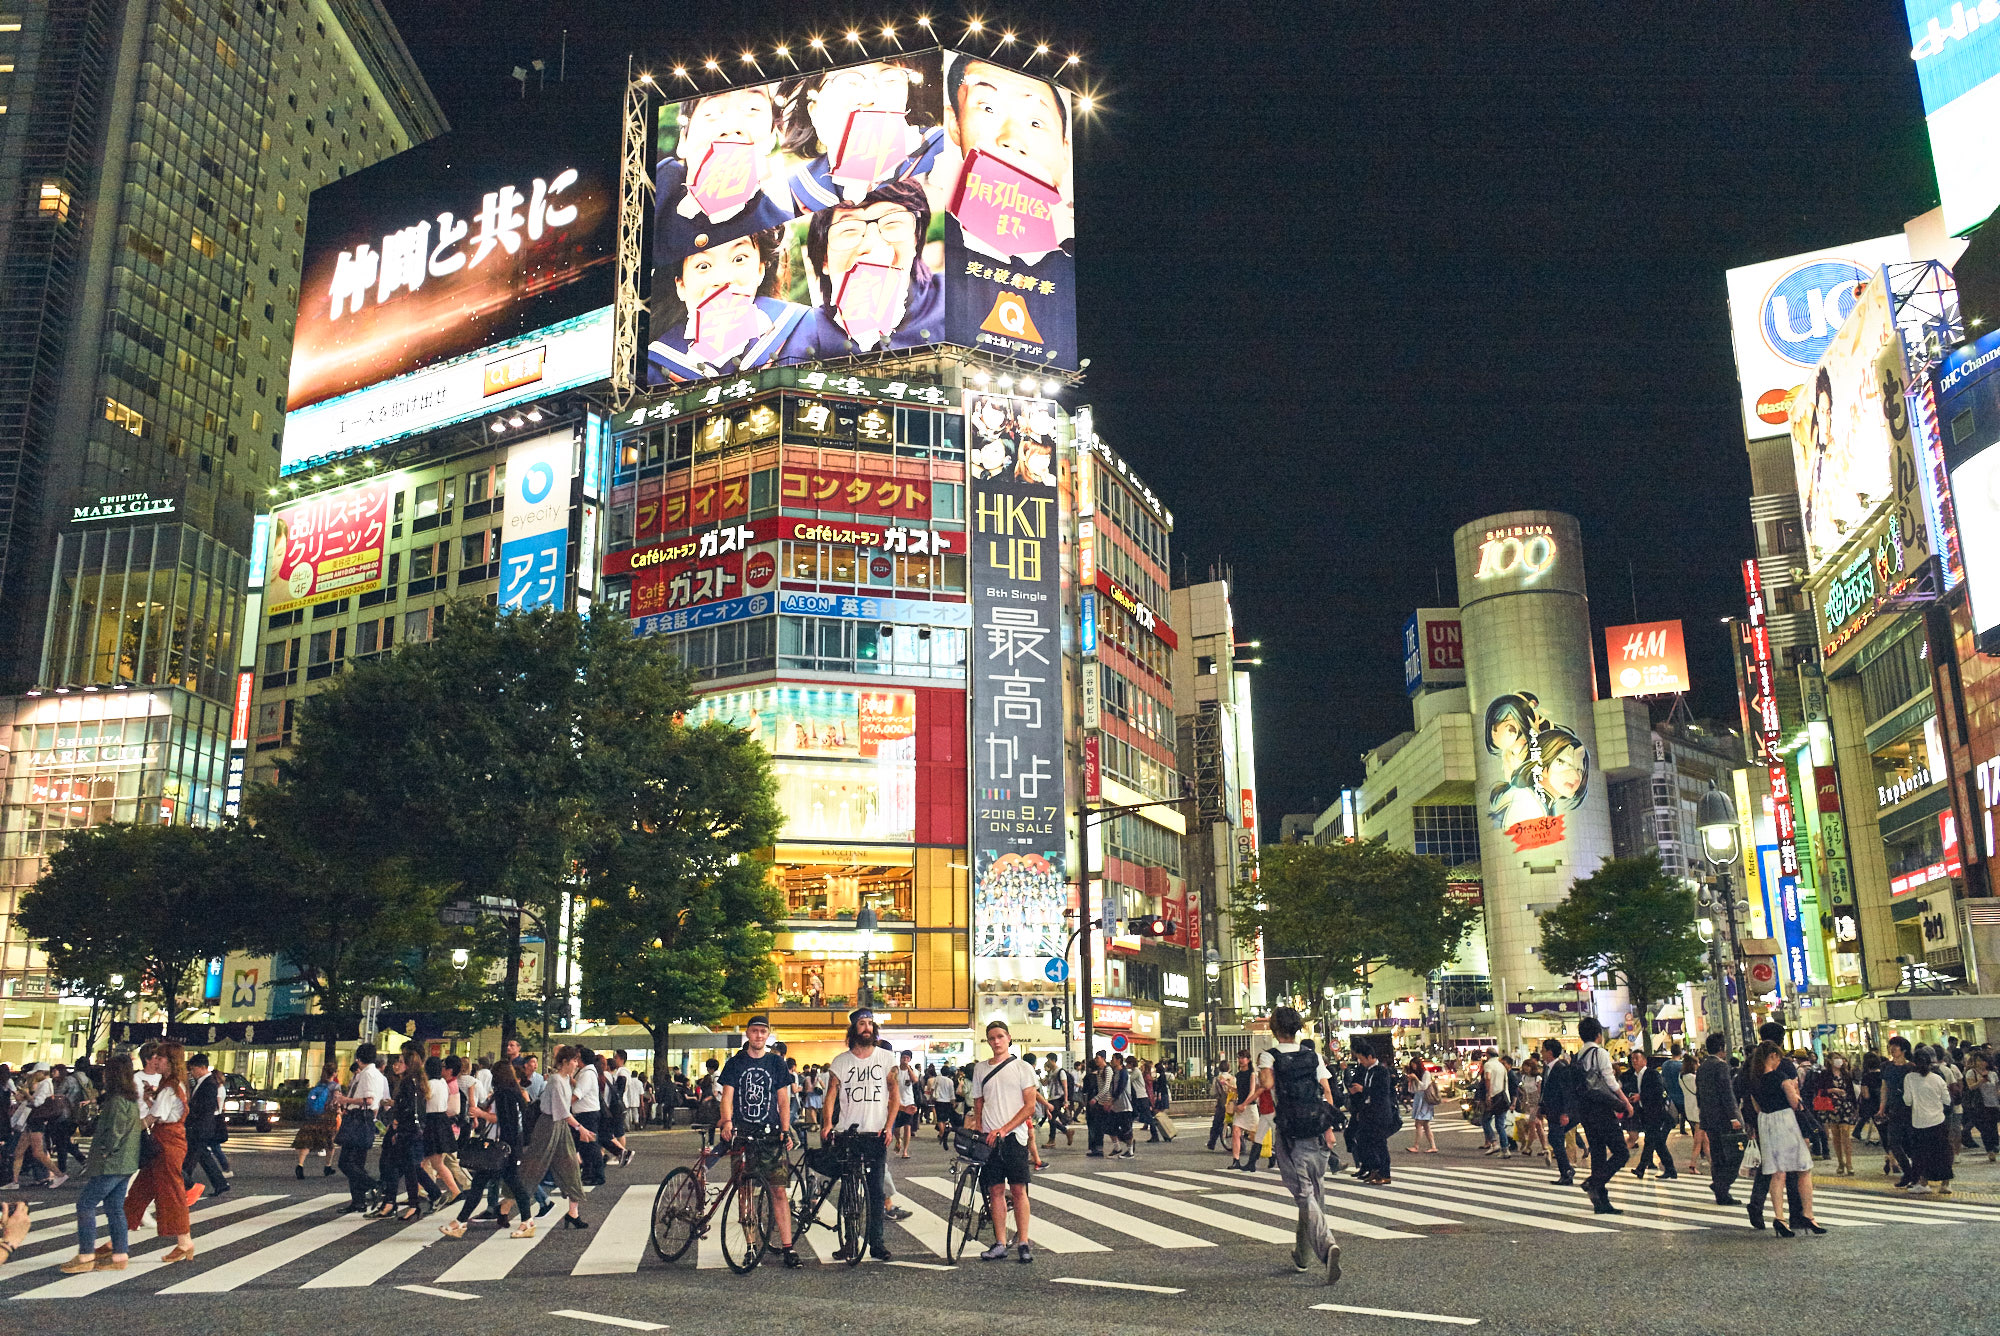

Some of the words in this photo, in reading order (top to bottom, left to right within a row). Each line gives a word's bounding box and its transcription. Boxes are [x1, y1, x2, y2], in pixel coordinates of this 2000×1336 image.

[328, 168, 579, 321] 仲間と共に
[984, 333, 1043, 356] 富士急ハランド
[1940, 368, 1961, 393] DHC
[798, 399, 811, 408] 9F
[100, 492, 148, 504] SHIBUYA
[782, 473, 927, 511] コンタクト
[73, 503, 126, 518] MARK
[129, 498, 174, 512] CITY
[289, 491, 386, 541] 品川スキン
[511, 504, 561, 531] eyecity
[638, 481, 748, 531] プライス
[975, 492, 1054, 538] HKT
[288, 518, 383, 567] クリニック
[699, 525, 754, 558] ガスト
[883, 527, 952, 555] ガスト
[1486, 526, 1553, 541] SHIBUYA
[990, 539, 1041, 582] 48
[1473, 535, 1557, 582] 109
[749, 564, 774, 580] ガスト
[294, 582, 306, 594] 4F
[637, 581, 666, 601] Café
[668, 565, 737, 609] ガスト
[987, 588, 1008, 598] 8th
[1011, 589, 1047, 601] Single
[750, 598, 767, 613] 6F
[785, 595, 830, 612] AEON
[1432, 627, 1459, 643] UN
[1622, 629, 1667, 661] H&M
[1434, 647, 1465, 665] QL
[983, 606, 1053, 798] 最高かよ
[1086, 668, 1095, 724] 渋谷駅前ビル
[57, 735, 122, 748] SHIBUYA
[101, 744, 161, 761] CITY
[981, 806, 1057, 821] 2016.9.7
[991, 822, 1010, 832] ON
[1016, 823, 1053, 833] SALE
